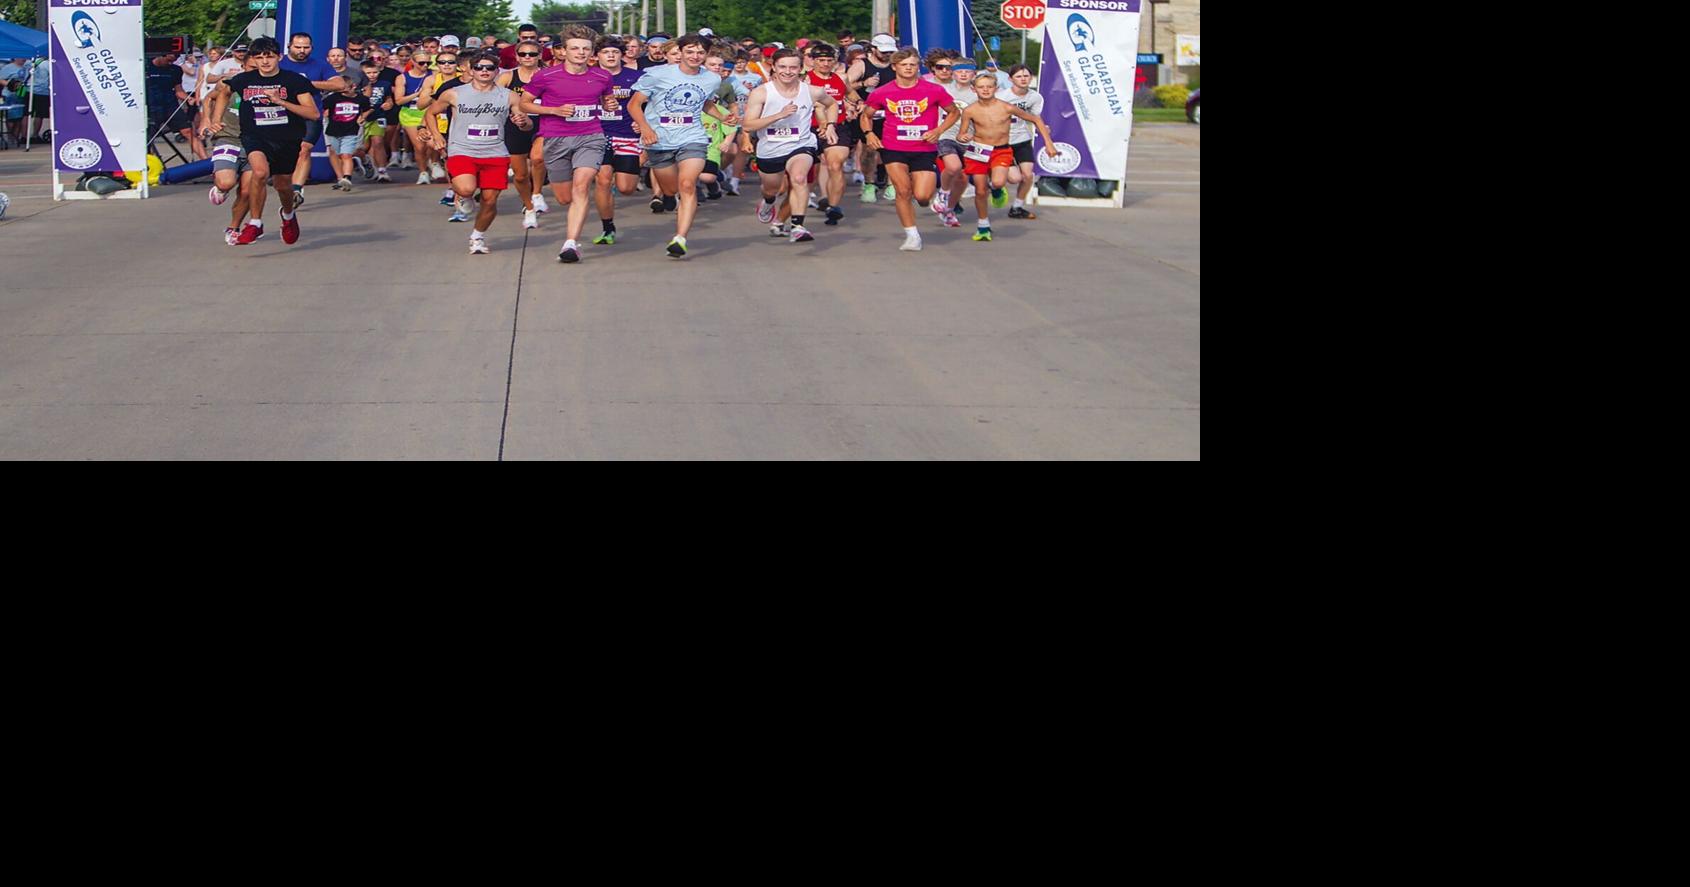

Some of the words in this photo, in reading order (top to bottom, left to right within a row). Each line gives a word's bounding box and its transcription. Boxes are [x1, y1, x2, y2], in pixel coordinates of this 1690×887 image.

[1060, 0, 1128, 10] SPONSOR
[1003, 5, 1044, 19] STOP
[73, 57, 81, 68] See
[86, 52, 112, 89] GLASS
[1078, 56, 1100, 95] GLASS
[100, 49, 137, 108] GUARDIAN
[1092, 54, 1123, 115] GUARDIAN
[264, 111, 278, 120] 115
[668, 116, 685, 124] 210
[774, 128, 792, 136] 259
